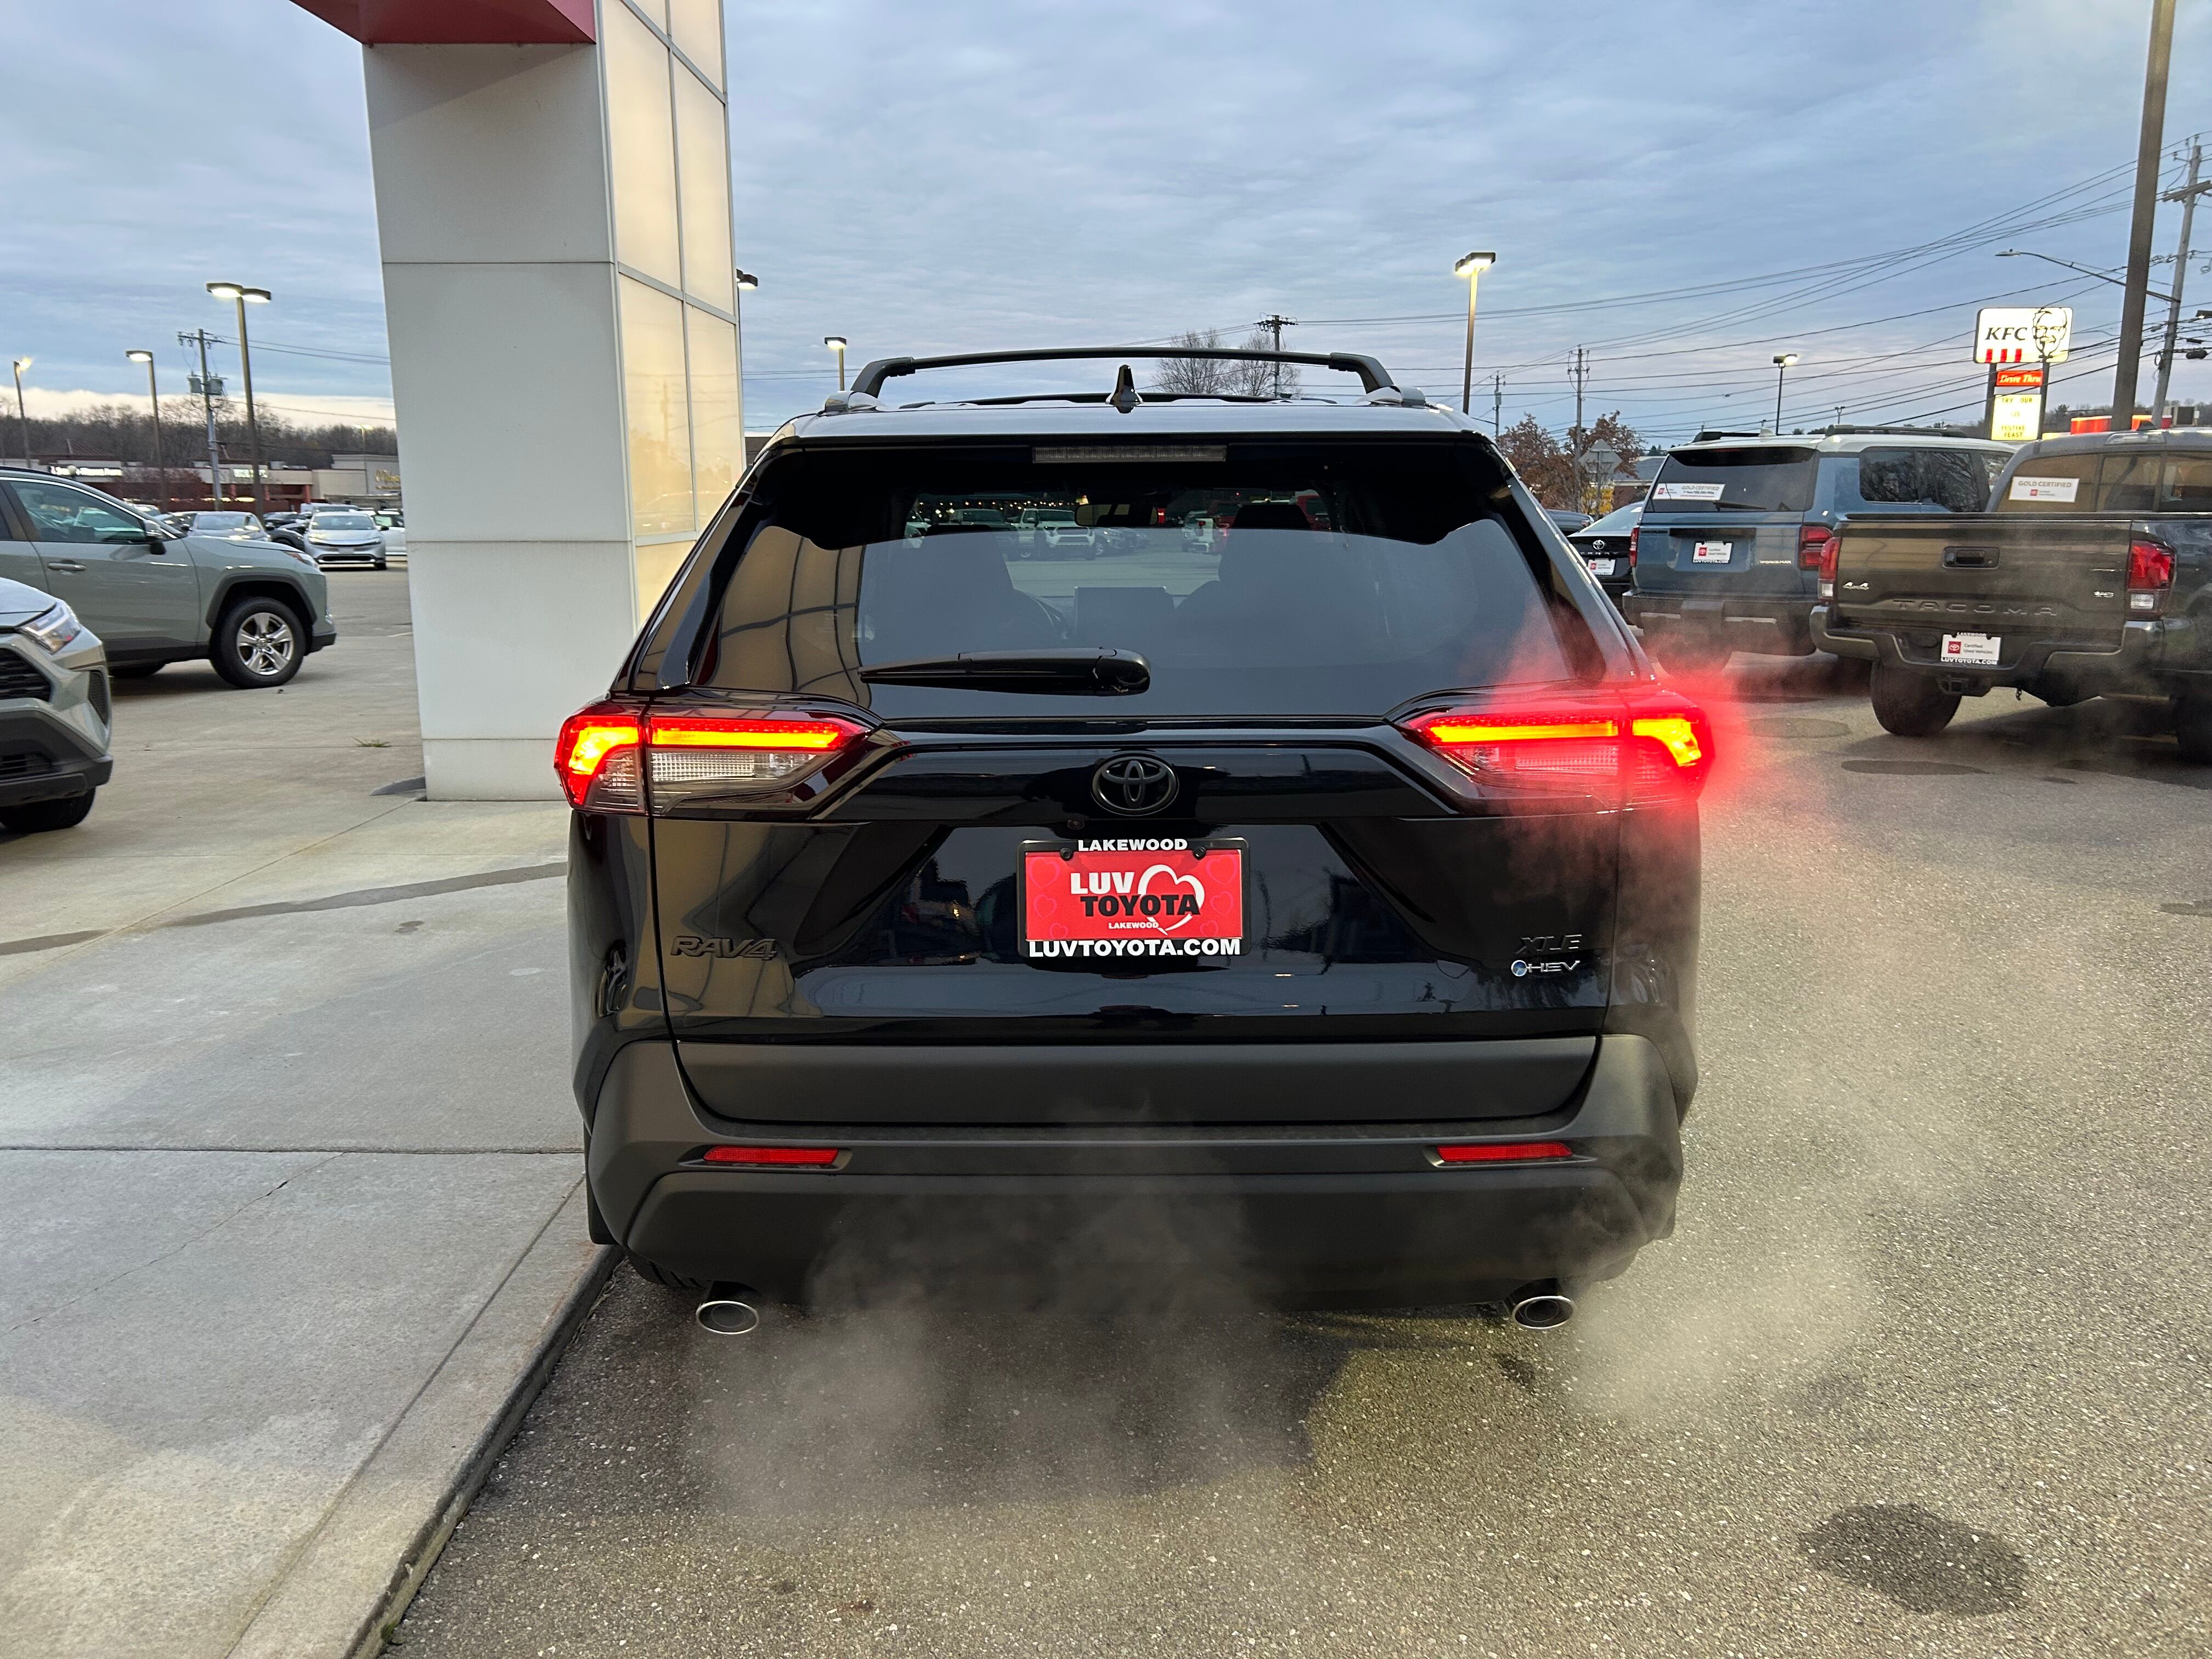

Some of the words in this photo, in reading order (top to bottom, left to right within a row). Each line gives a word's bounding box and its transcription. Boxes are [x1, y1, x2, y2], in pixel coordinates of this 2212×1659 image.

[1985, 327, 2028, 341] KFC
[2023, 374, 2041, 382] Thru
[1893, 600, 2057, 616] TACOMA
[1078, 839, 1187, 851] LAKEWOOD
[1070, 872, 1135, 895] LUV
[1080, 894, 1200, 917] TOYOTA
[1108, 921, 1159, 929] LAKEWOOD
[670, 935, 777, 960] RAV4
[1029, 938, 1240, 957] LUVTOYOTA.COM
[1515, 934, 1582, 954] XLE
[1527, 961, 1581, 973] HEV
